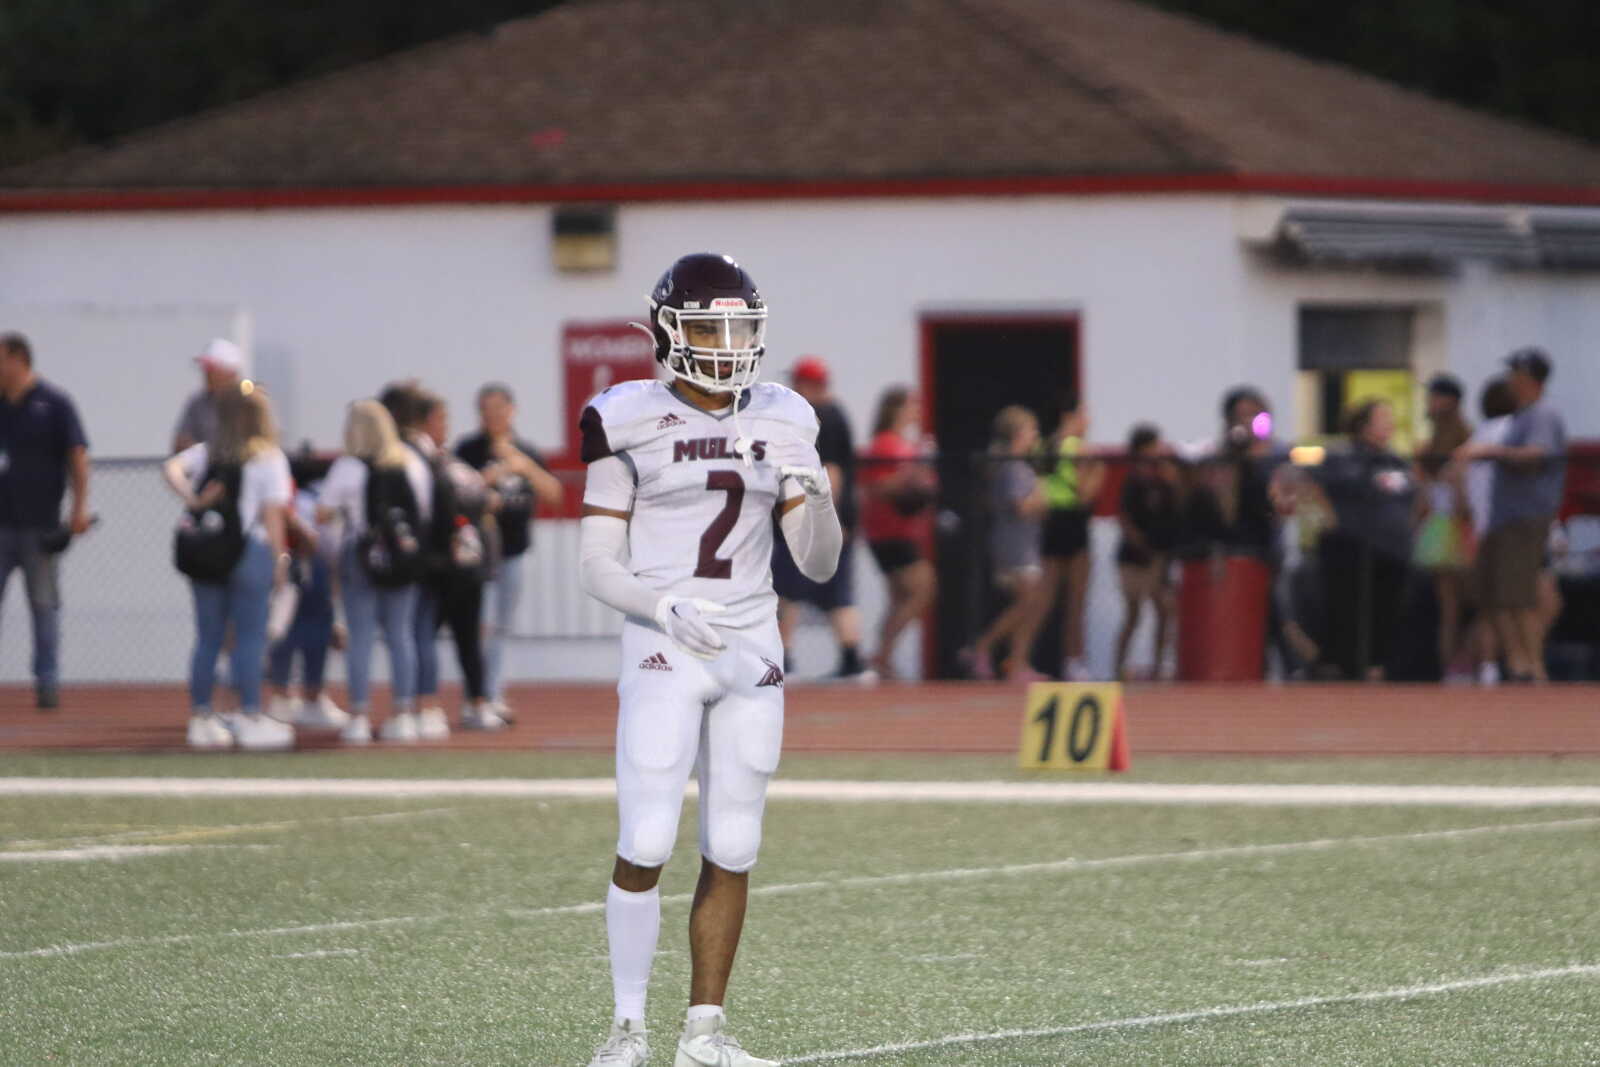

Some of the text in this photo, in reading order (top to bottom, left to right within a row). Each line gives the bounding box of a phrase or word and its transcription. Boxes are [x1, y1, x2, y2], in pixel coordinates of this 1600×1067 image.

[673, 437, 767, 463] MULS
[693, 470, 746, 579] 2
[639, 662, 673, 672] adidas
[1033, 692, 1102, 762] 10
